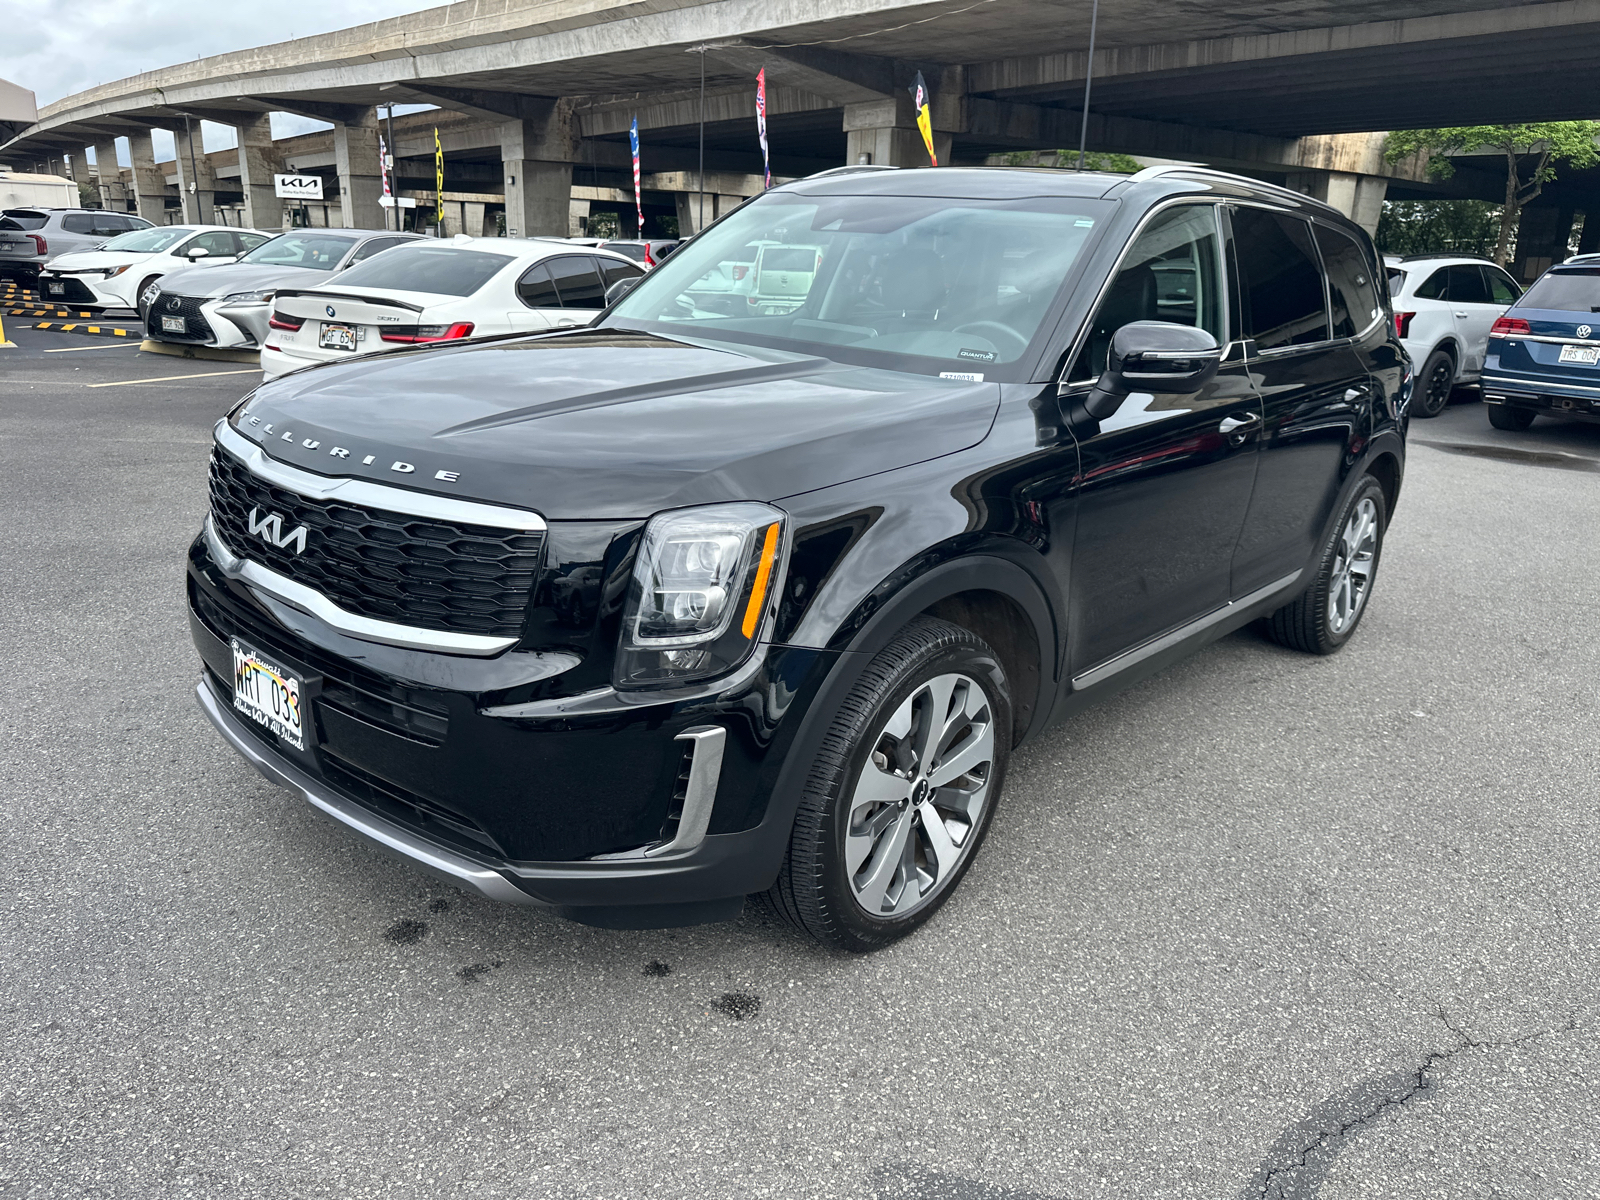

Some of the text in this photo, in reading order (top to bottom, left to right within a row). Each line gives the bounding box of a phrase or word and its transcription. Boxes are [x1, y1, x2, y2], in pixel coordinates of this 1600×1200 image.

[281, 178, 318, 188] KIA
[321, 328, 336, 342] WGF
[340, 330, 355, 345] 654
[1563, 349, 1597, 361] TRS 004
[239, 408, 461, 483] TELLURIDE
[249, 506, 308, 555] KIA
[235, 655, 301, 728] WRT 033
[233, 697, 252, 716] Aloha
